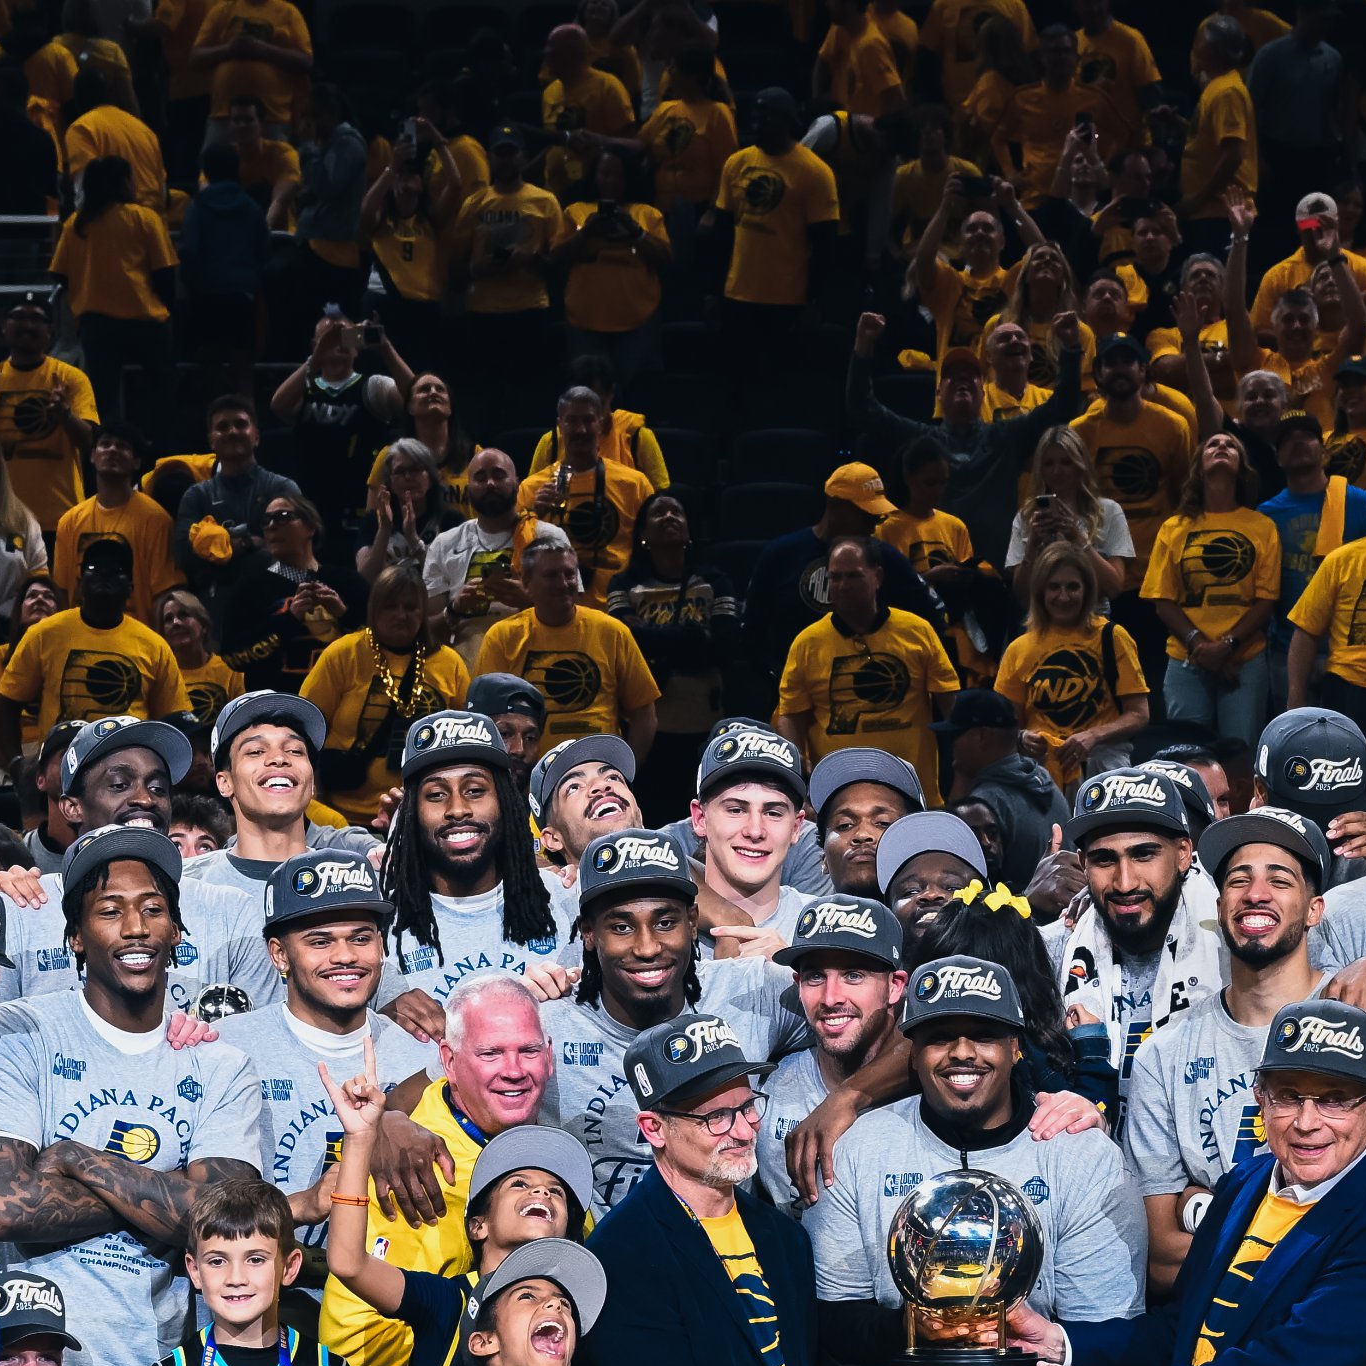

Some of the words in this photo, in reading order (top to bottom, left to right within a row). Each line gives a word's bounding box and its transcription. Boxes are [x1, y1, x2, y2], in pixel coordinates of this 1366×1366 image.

[431, 717, 492, 748] Finals
[728, 732, 793, 767] Finals
[1299, 757, 1363, 791] Finals
[1096, 774, 1166, 811] Finals
[609, 837, 679, 874] Finals
[310, 861, 373, 898] Finals
[805, 904, 877, 938] Finals
[433, 951, 493, 1000] IANA
[928, 966, 1002, 1003] Finals
[1286, 1016, 1365, 1059] Finals
[584, 1072, 627, 1146] INDIA
[104, 1243, 126, 1252] NBA
[104, 1249, 166, 1269] CONFERENCE
[79, 1256, 141, 1276] CHAMPIONS
